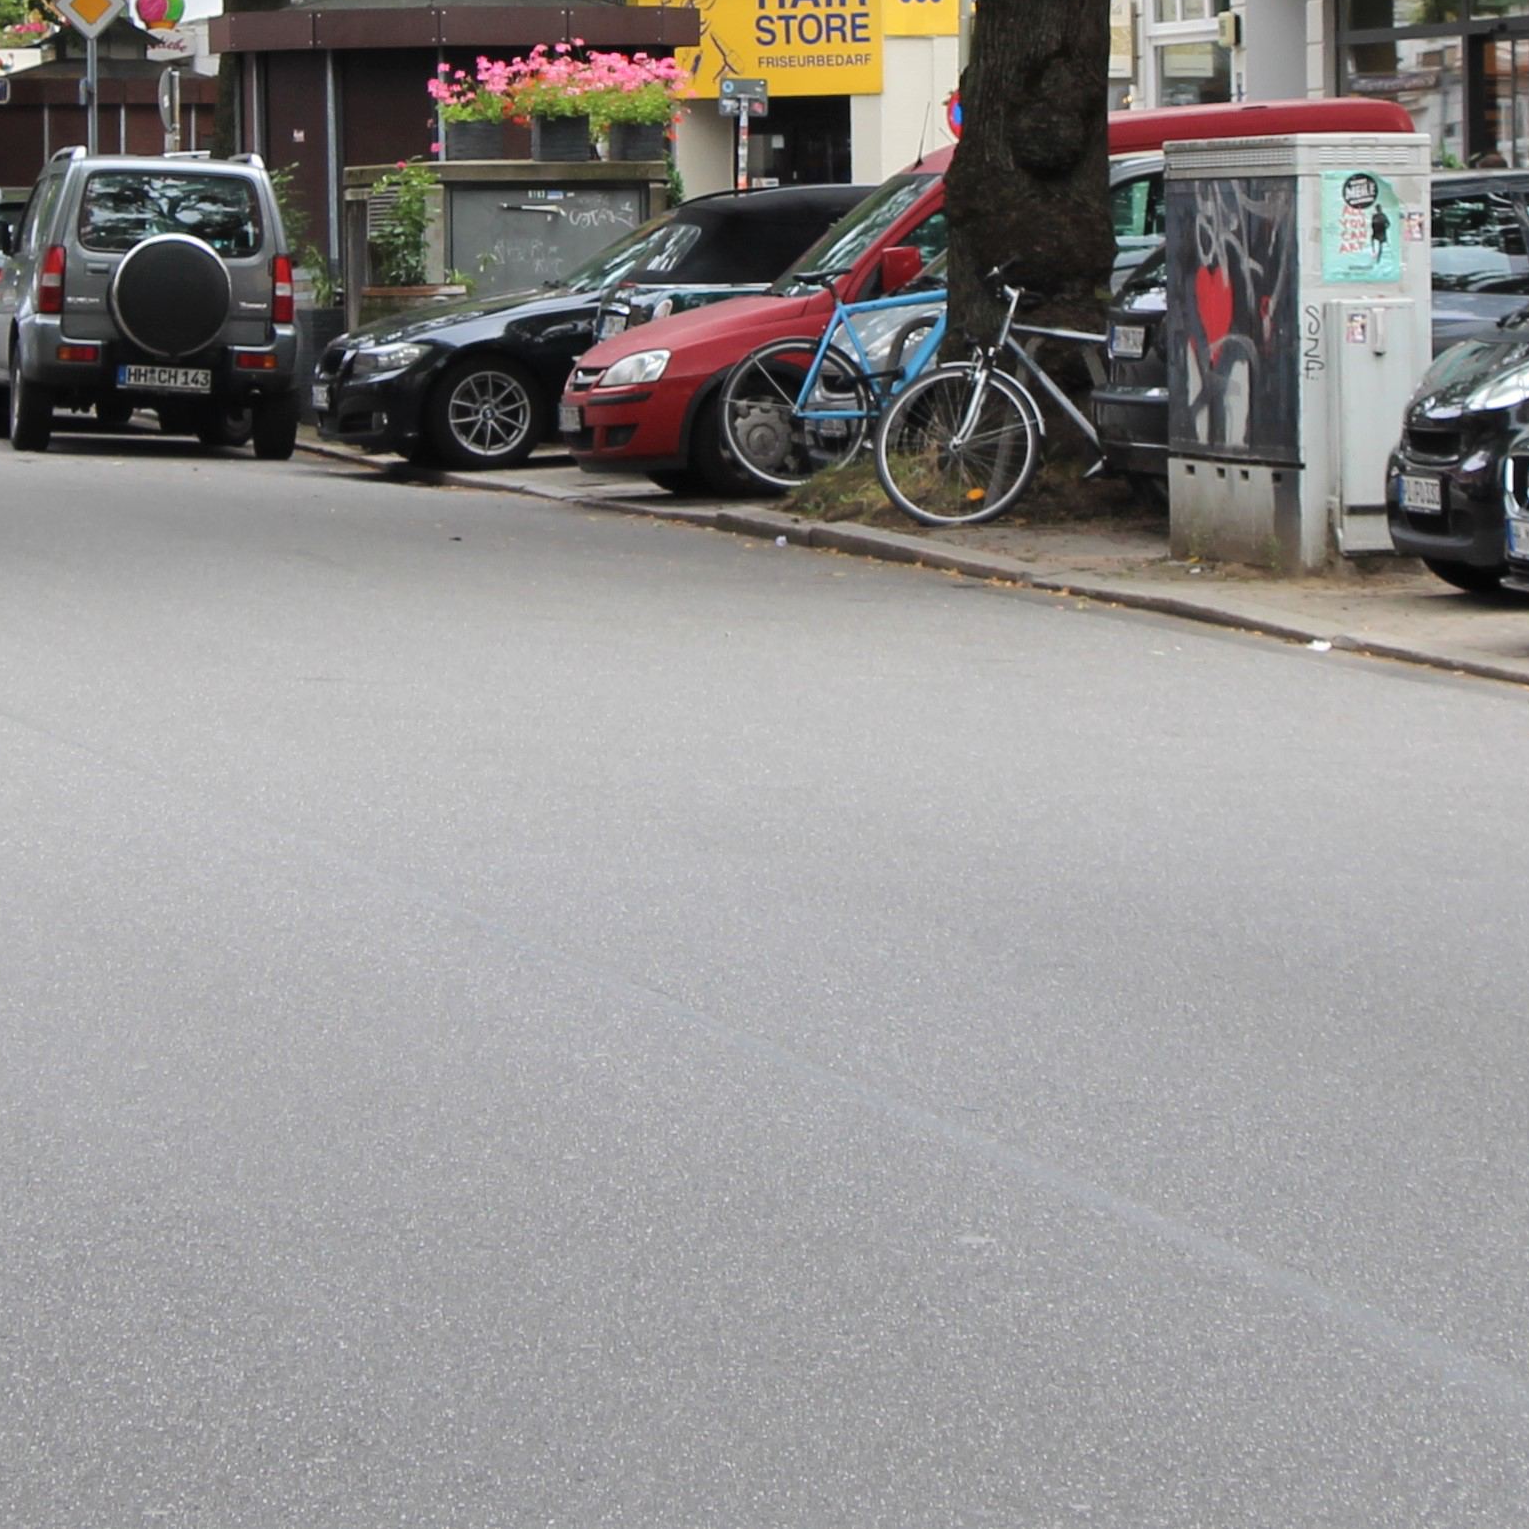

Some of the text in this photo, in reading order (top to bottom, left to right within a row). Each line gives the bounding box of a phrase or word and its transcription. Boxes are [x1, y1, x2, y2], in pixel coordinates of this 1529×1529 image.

[755, 13, 871, 46] STORE
[757, 53, 872, 69] FRISEURBEDARF
[128, 367, 210, 387] HH CH 143
